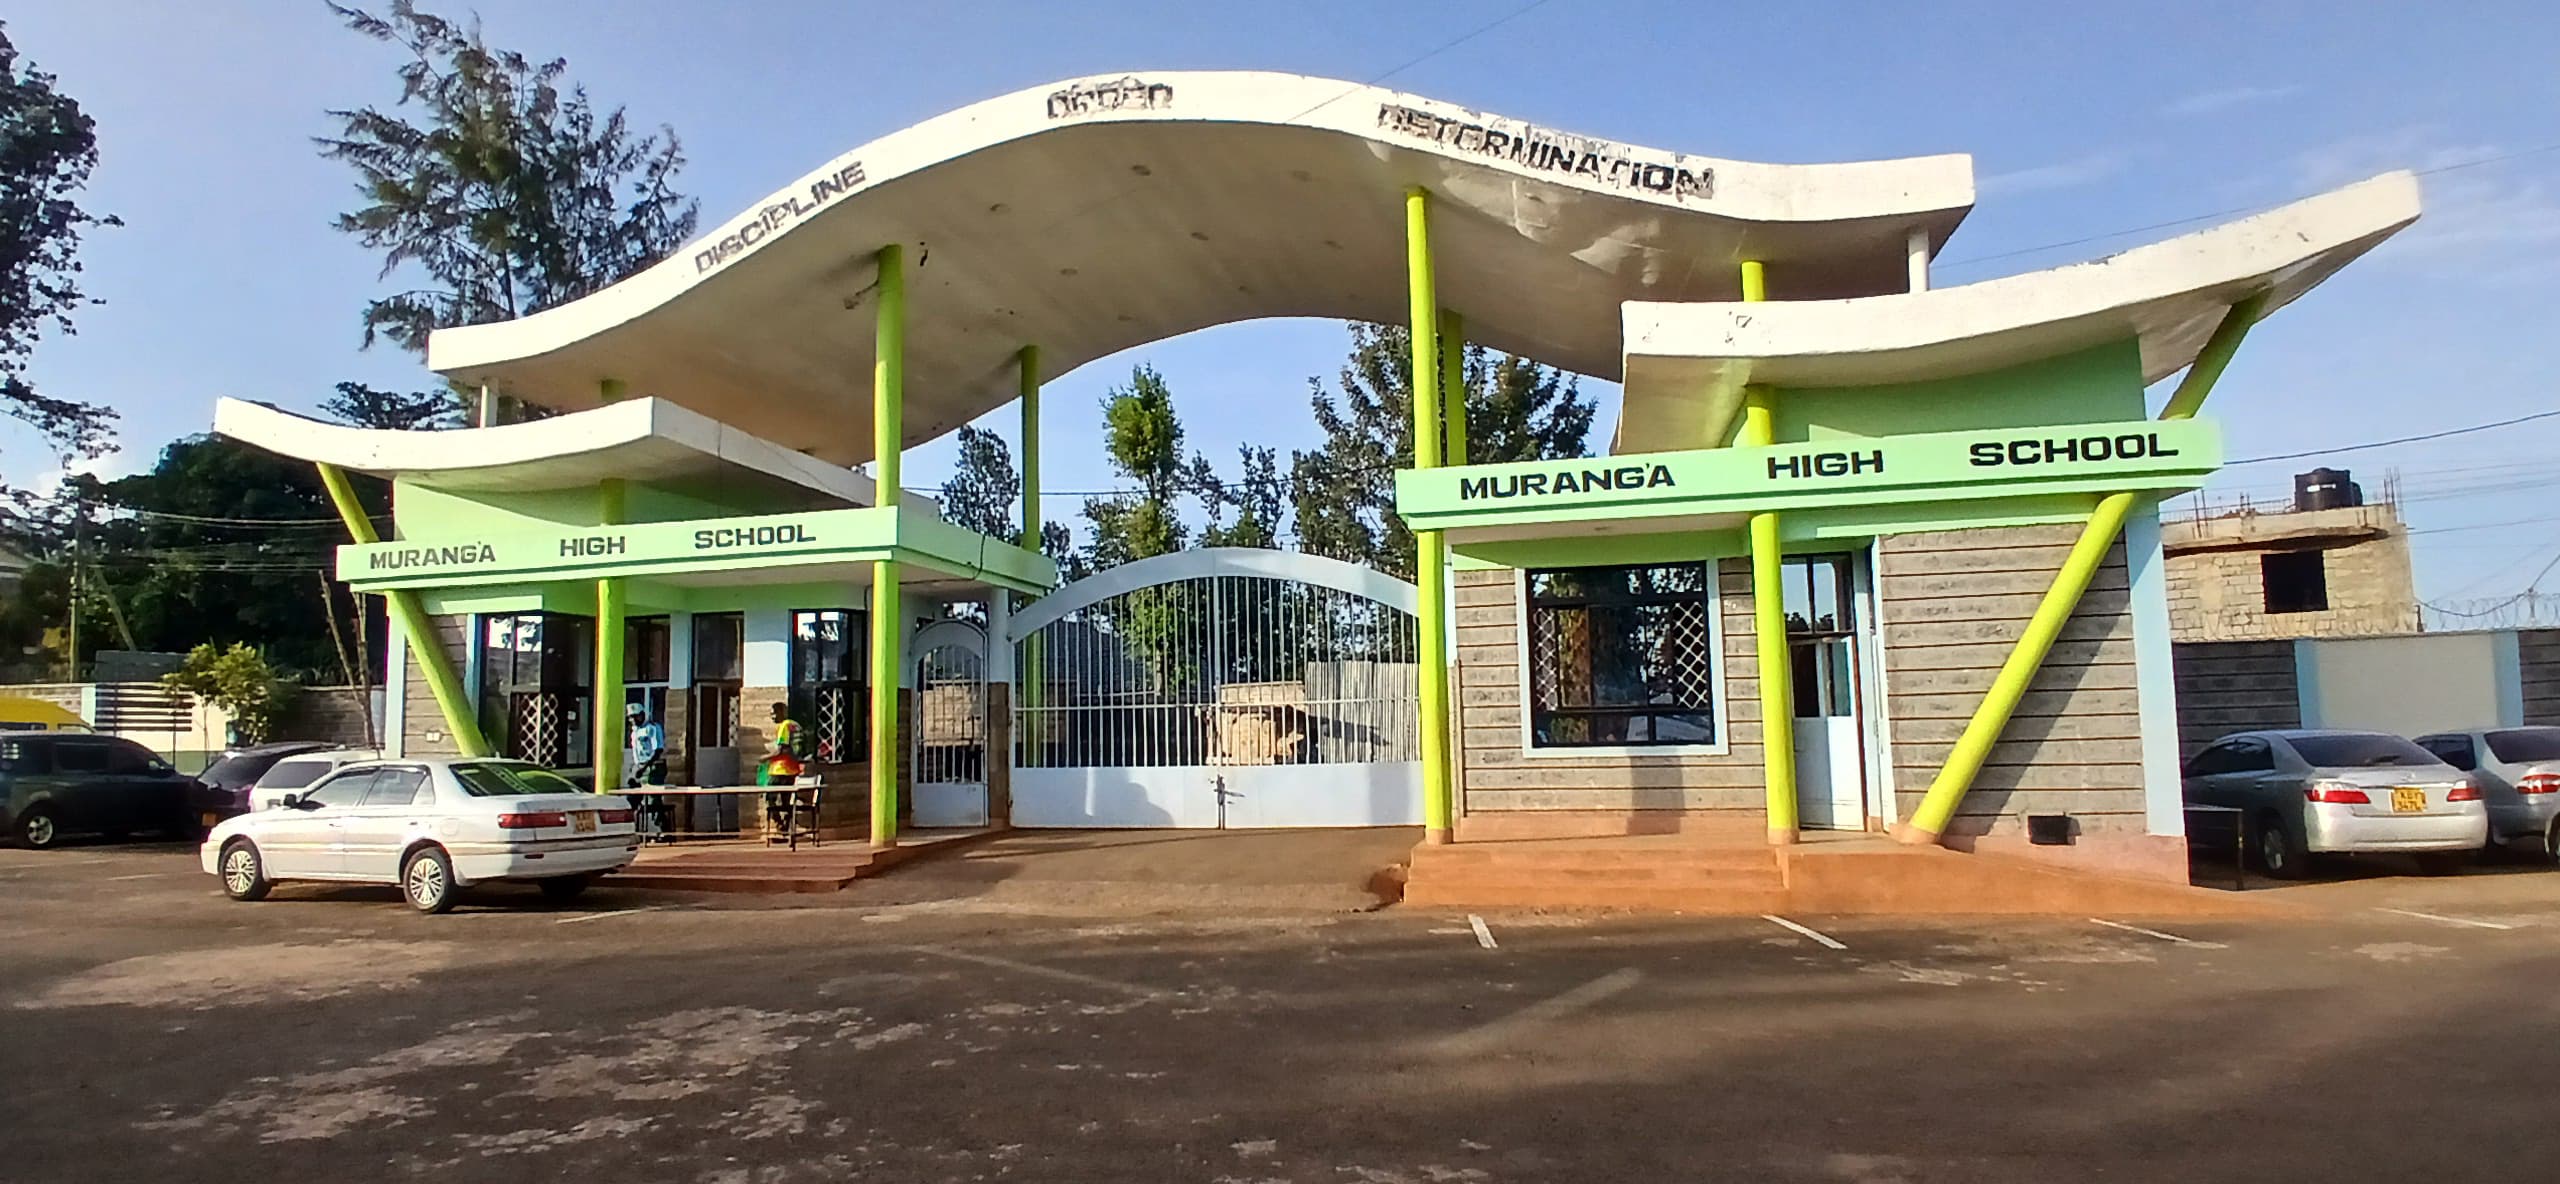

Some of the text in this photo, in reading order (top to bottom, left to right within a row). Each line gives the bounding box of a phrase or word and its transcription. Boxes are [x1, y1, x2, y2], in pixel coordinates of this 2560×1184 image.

[695, 160, 866, 275] DISCIPLINE
[1460, 434, 2180, 500] MURANG'A HIGH SCHOOL
[370, 524, 816, 570] MURANG'A HIGH SCHOOL
